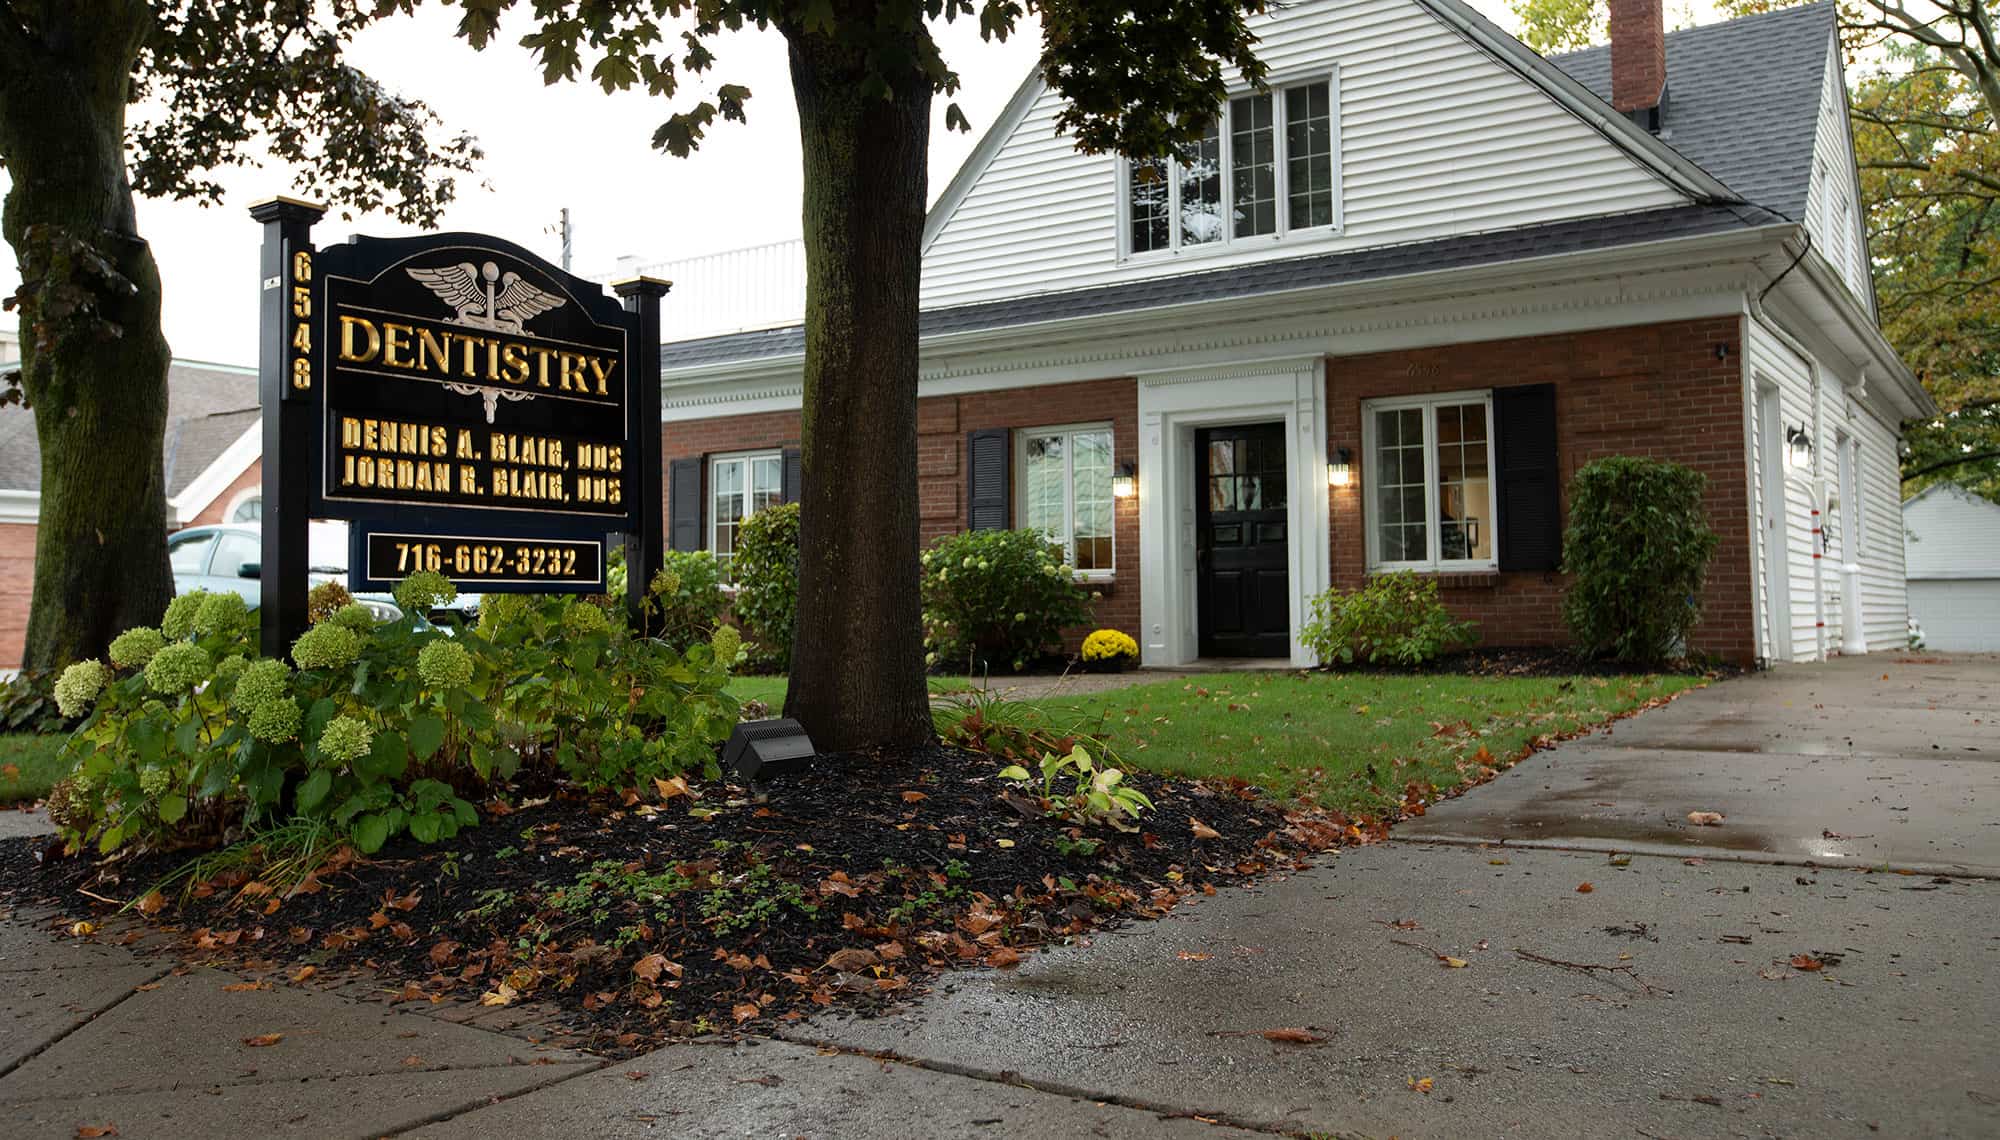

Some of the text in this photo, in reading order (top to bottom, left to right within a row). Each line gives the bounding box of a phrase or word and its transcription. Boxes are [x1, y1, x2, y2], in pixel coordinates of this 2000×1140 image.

[293, 251, 312, 390] 6548
[339, 315, 617, 395] DENTISTRY
[342, 416, 622, 473] DENNIS A. BLAIR, DDS
[342, 455, 621, 504] JORDAN R. BLAIR, DDS
[395, 543, 577, 576] 716-662-3232
